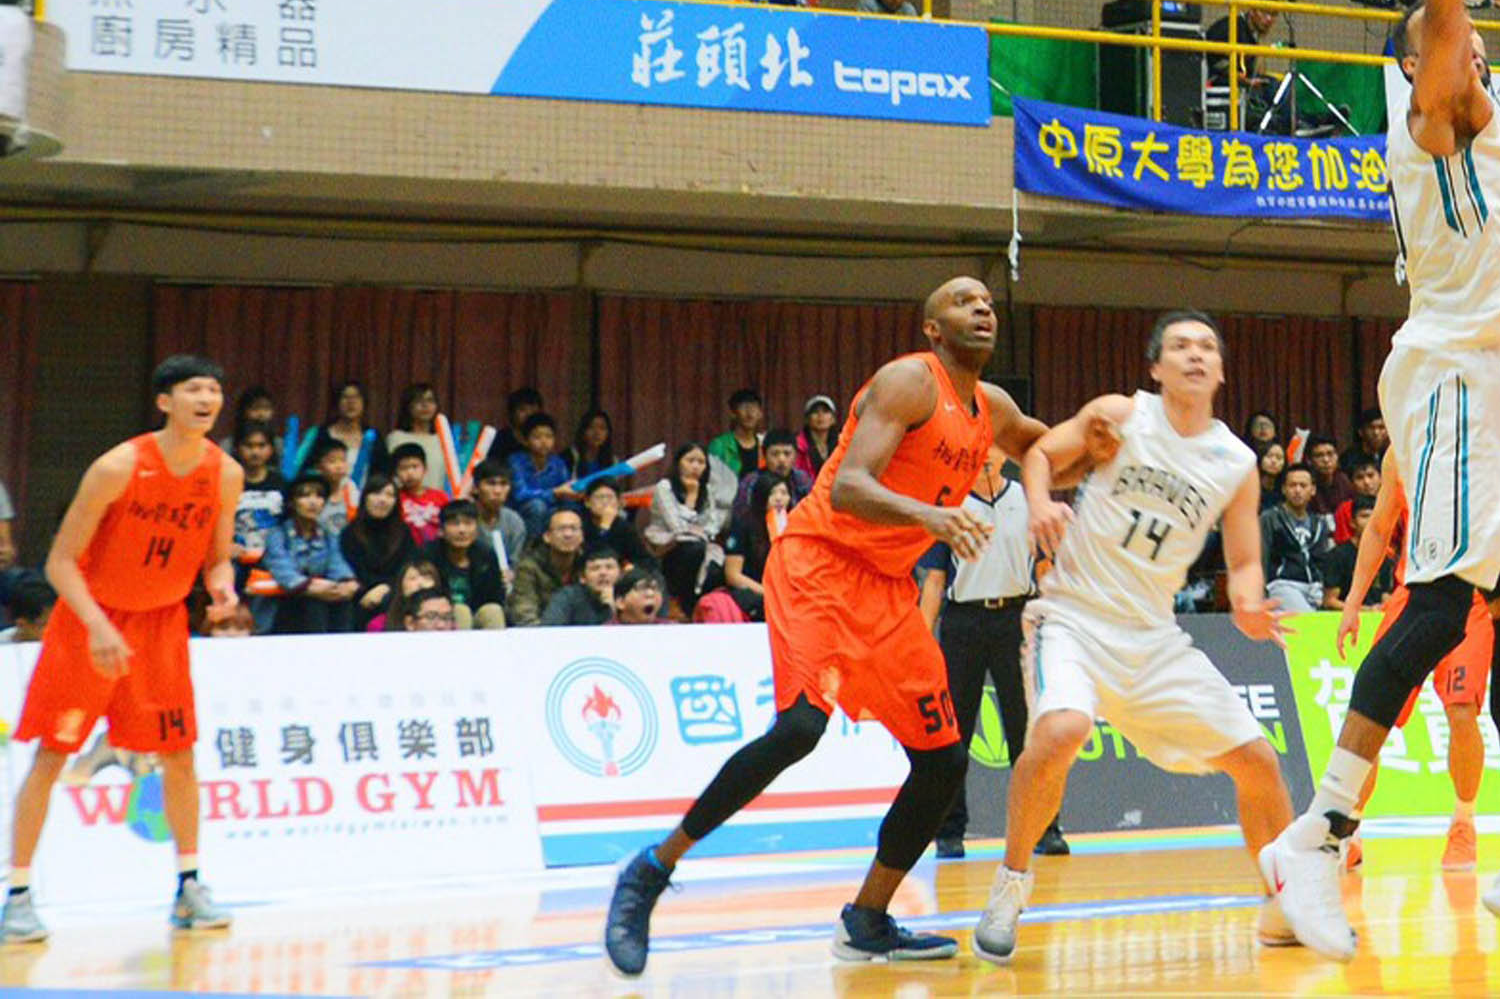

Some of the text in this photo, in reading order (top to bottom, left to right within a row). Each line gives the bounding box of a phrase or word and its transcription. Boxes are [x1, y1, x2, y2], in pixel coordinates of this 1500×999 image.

[90, 14, 316, 68] 廚房精品
[631, 8, 973, 105] 莊頭北 topax
[1038, 118, 1390, 194] 中原大學為您加油
[142, 535, 175, 569] 14
[1122, 508, 1173, 561] 14
[1446, 665, 1468, 694] 12
[158, 708, 187, 742] 14
[917, 688, 955, 736] 50
[214, 716, 495, 769] 健身俱樂部
[355, 767, 505, 814] GYM
